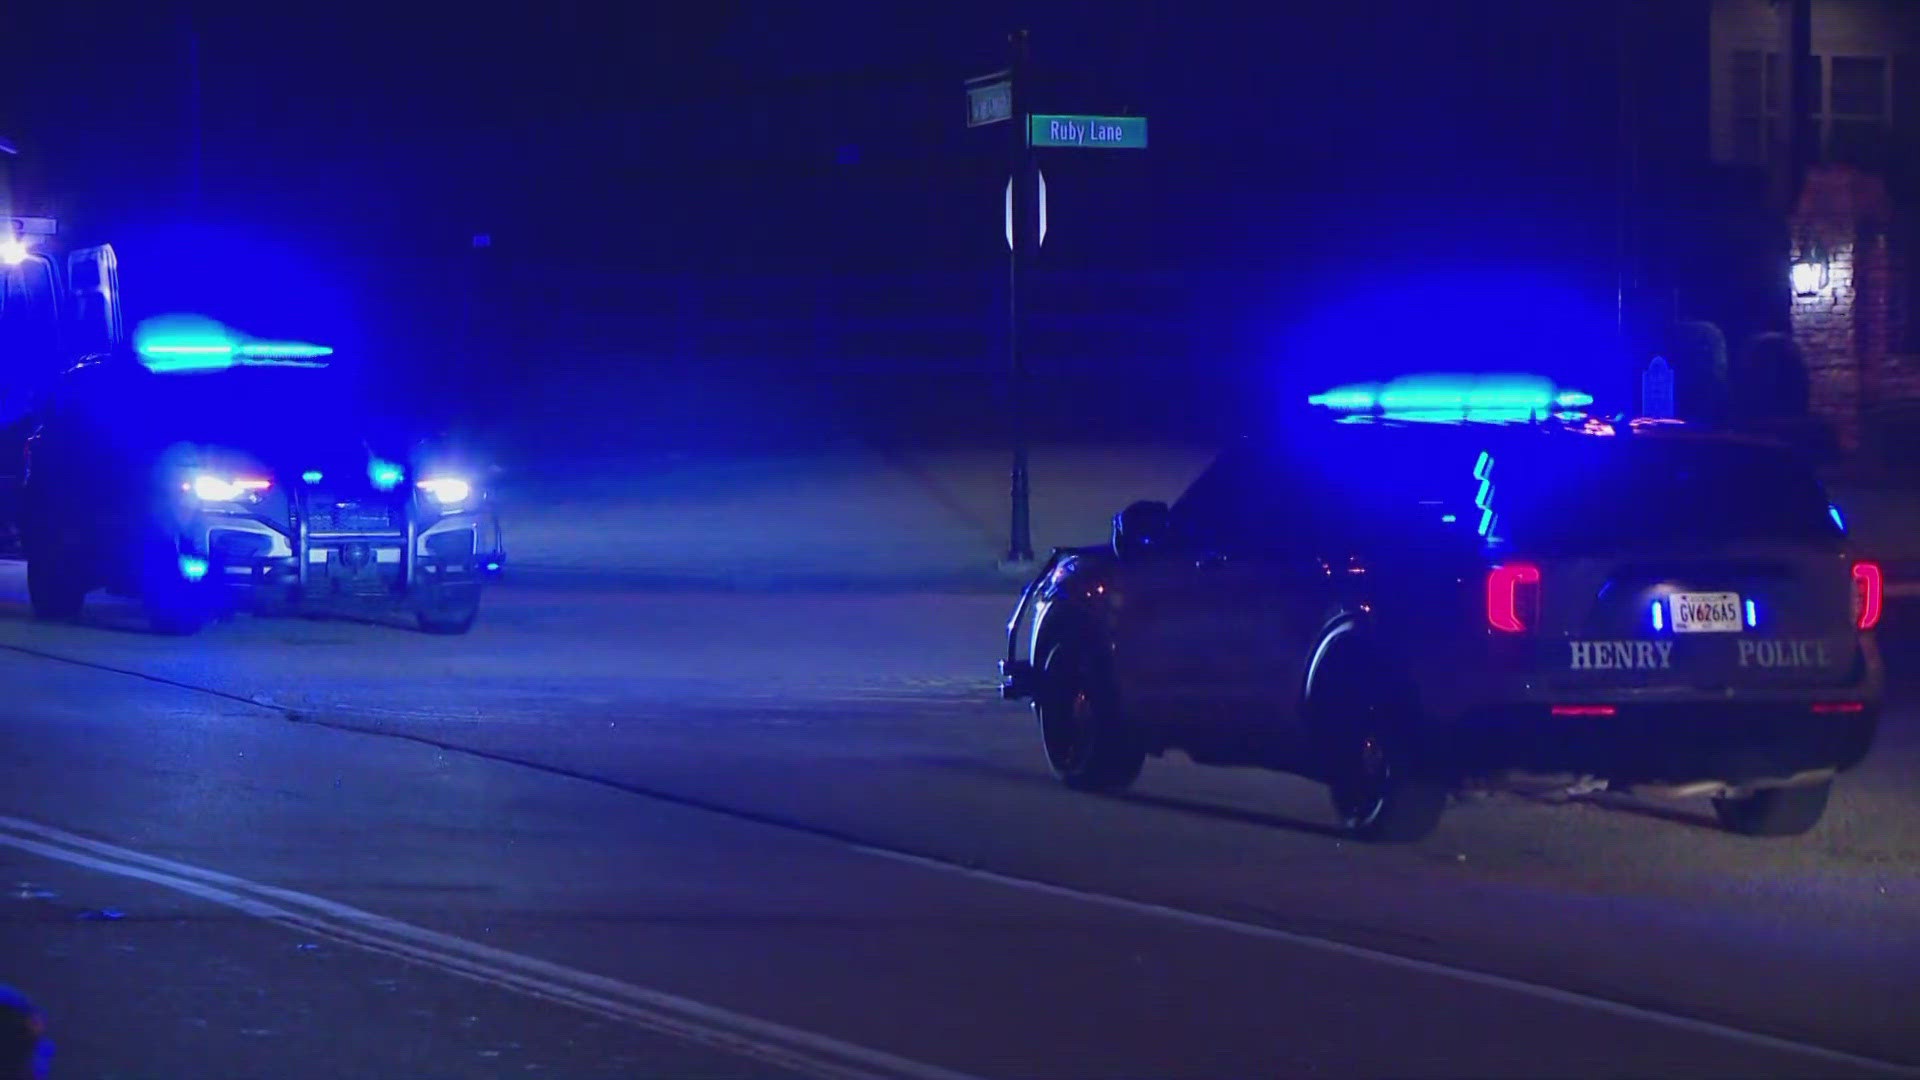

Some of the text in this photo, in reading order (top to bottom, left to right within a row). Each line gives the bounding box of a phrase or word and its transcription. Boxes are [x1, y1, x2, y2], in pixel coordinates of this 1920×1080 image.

[1051, 121, 1122, 144] Ruby Lane
[1680, 602, 1737, 622] GV626A5
[1570, 640, 1830, 670] HENRY POLICE
